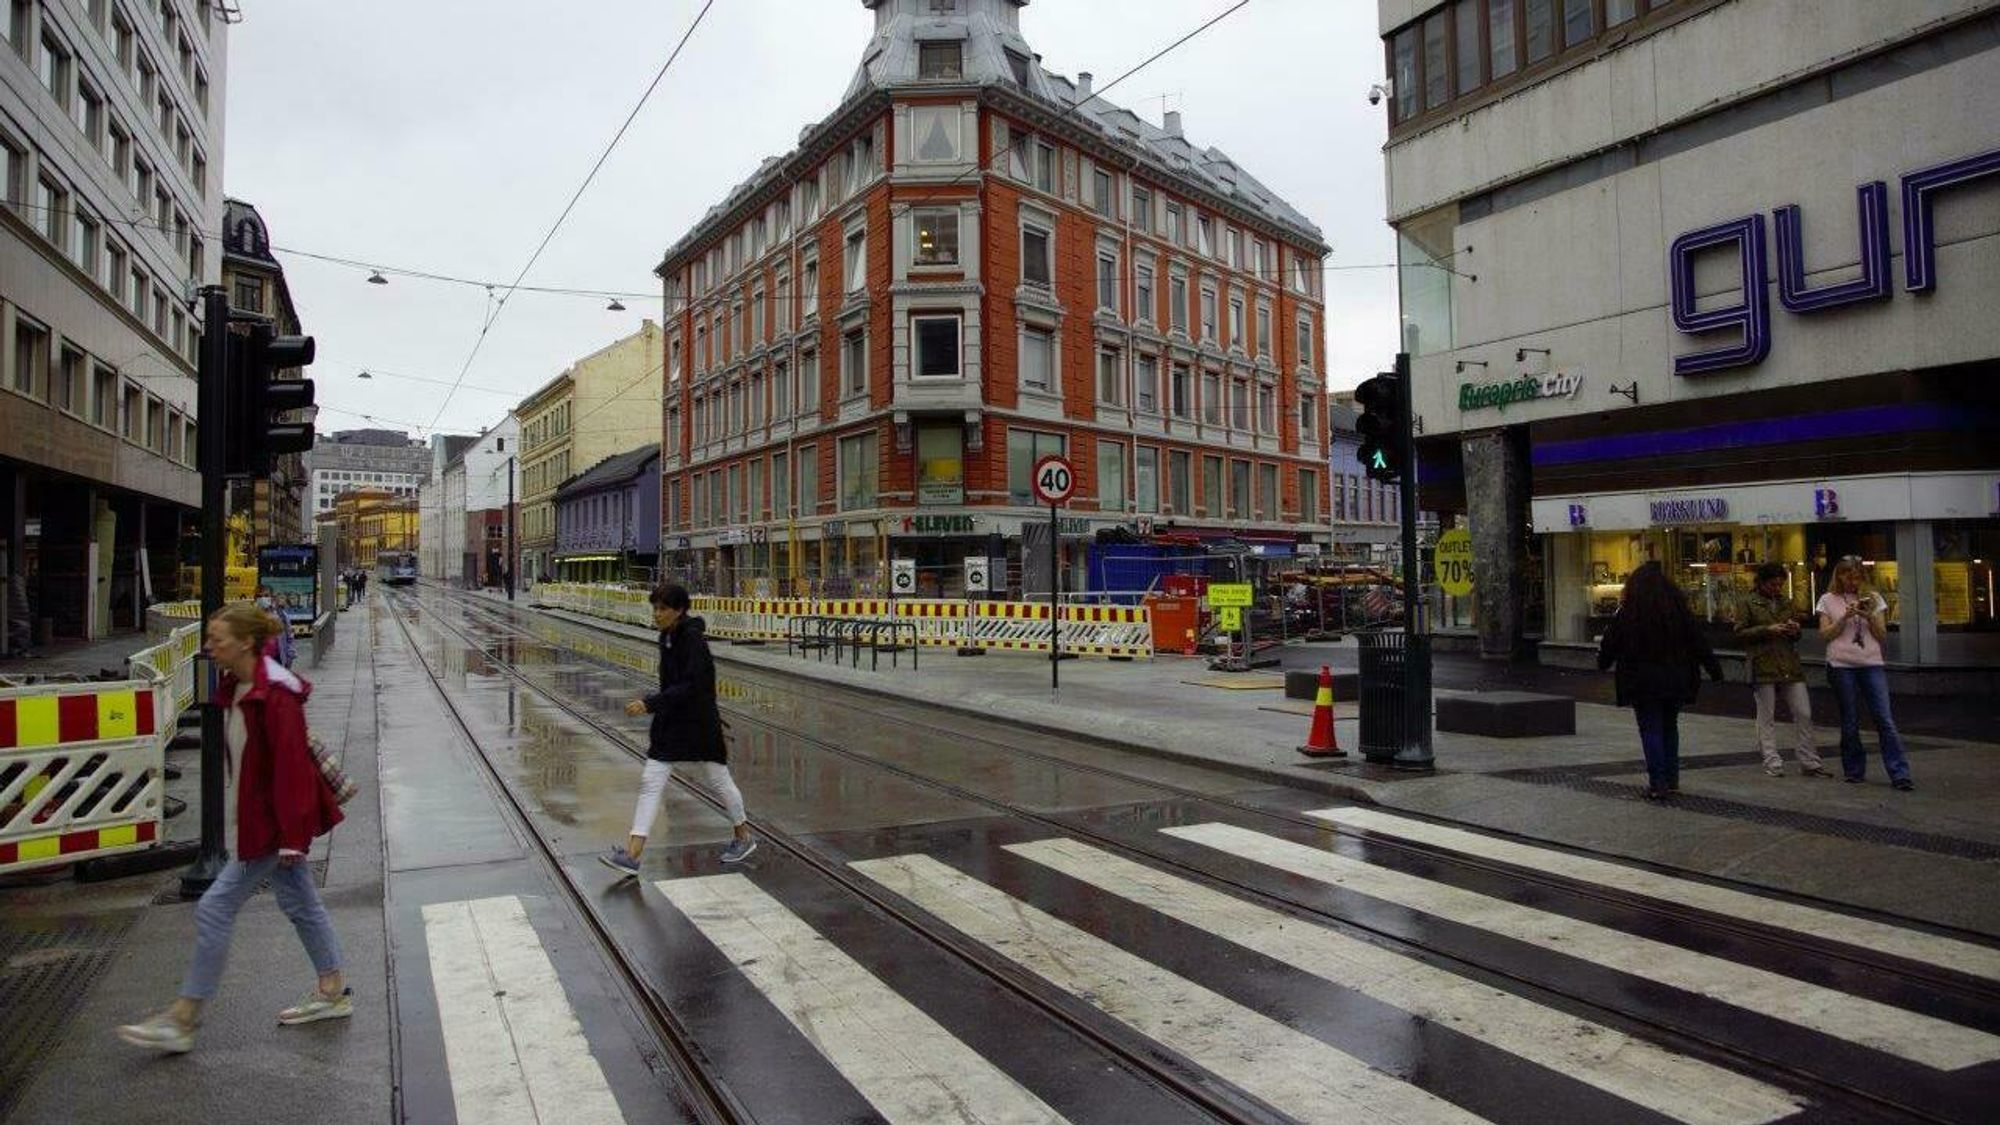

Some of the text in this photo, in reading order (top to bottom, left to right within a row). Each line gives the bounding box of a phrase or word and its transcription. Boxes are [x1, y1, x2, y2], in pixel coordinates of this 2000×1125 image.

[1541, 371, 1582, 400] City
[1040, 468, 1070, 491] 40
[1441, 560, 1475, 583] 70%
